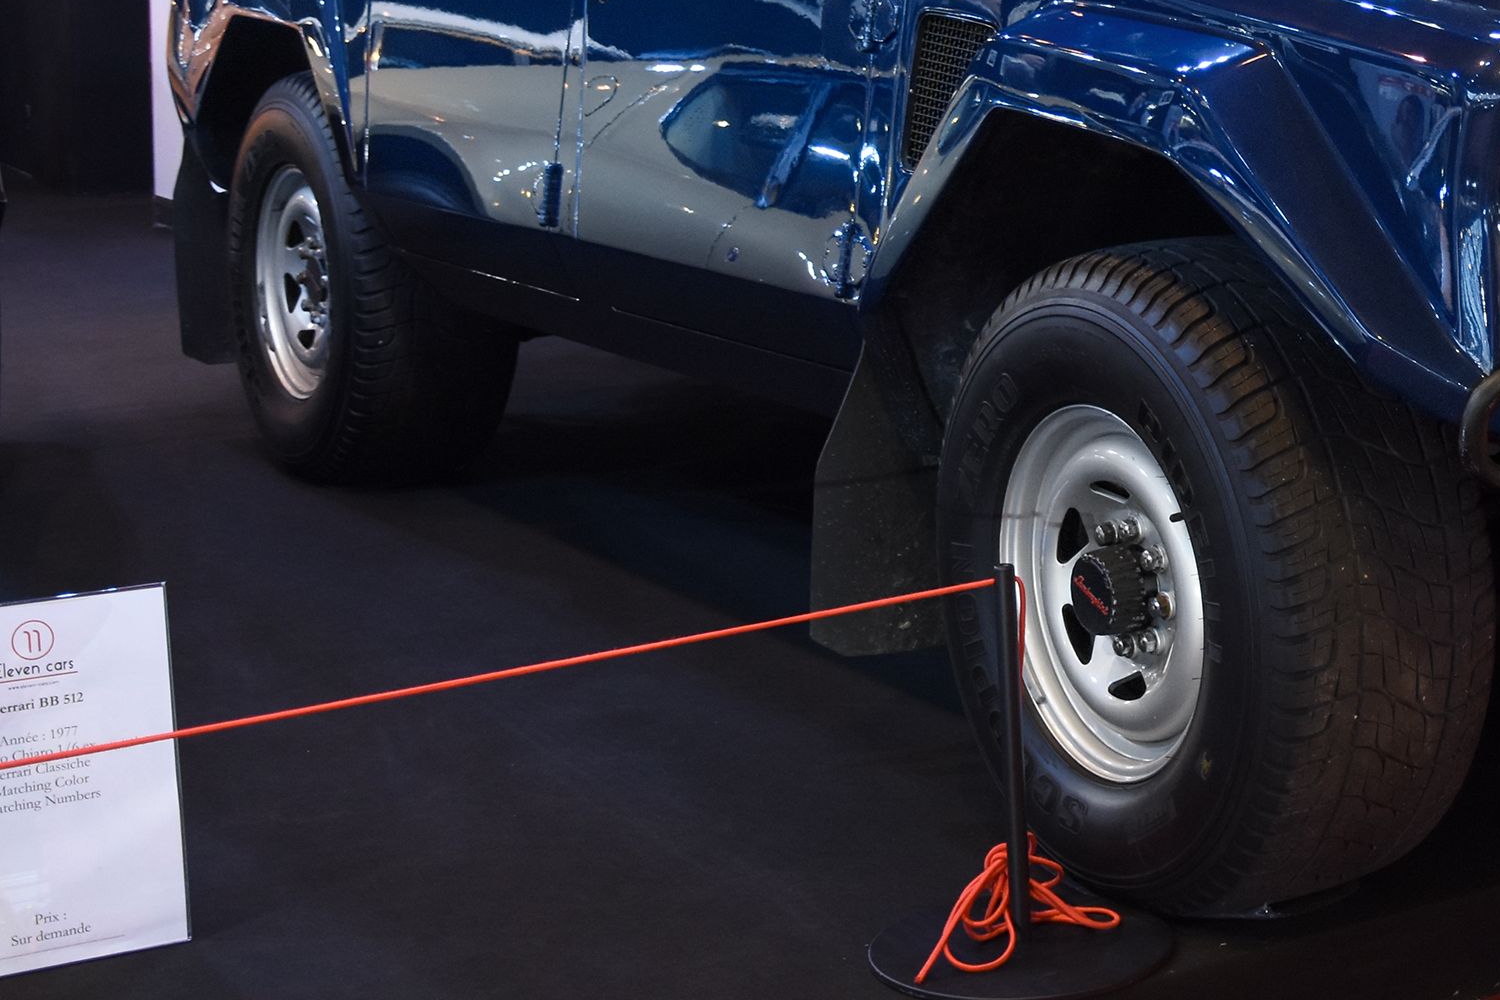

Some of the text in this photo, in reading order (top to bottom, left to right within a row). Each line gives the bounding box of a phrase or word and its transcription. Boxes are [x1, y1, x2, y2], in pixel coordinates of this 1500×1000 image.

[46, 660, 74, 672] cars
[0, 692, 84, 714] errari BB 512
[0, 732, 39, 747] Année
[50, 725, 78, 739] 1977
[0, 758, 91, 780] errari Classiche
[55, 775, 90, 788] Color
[0, 790, 102, 814] tching Numbers
[35, 911, 59, 925] Prix
[11, 922, 91, 947] Sur demande
